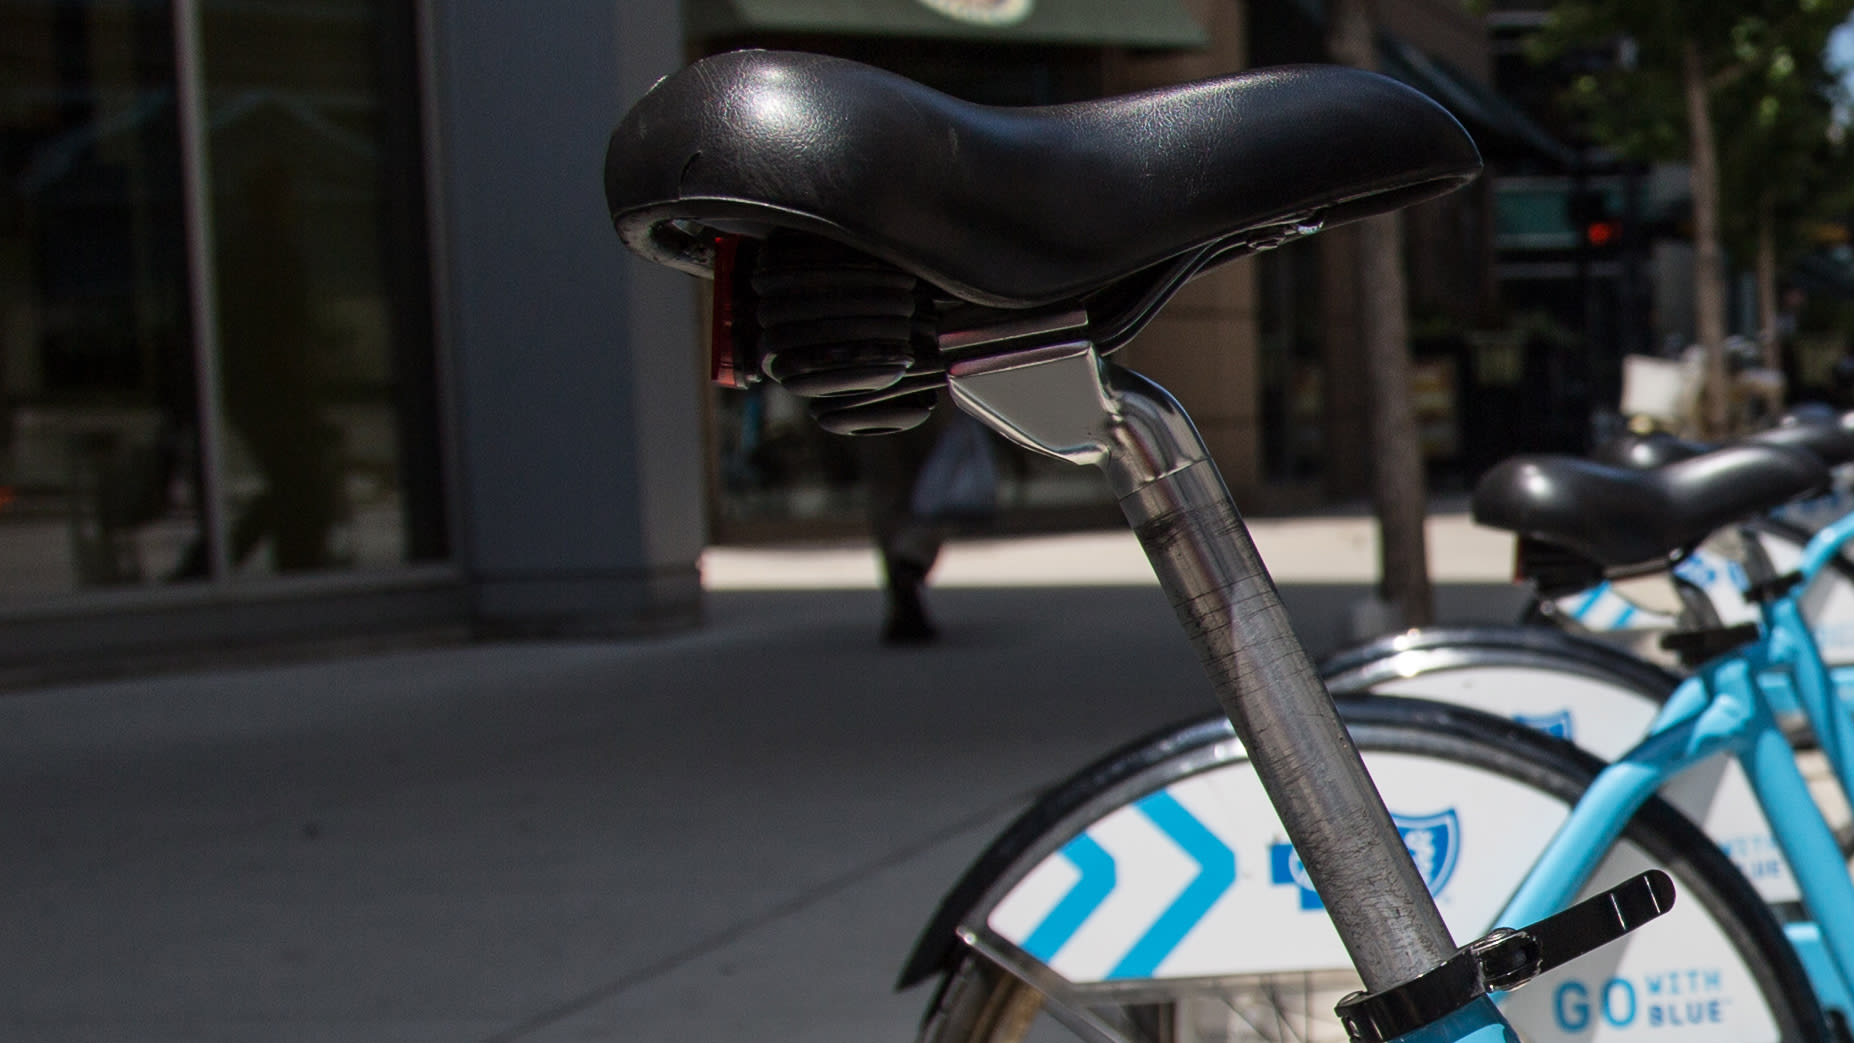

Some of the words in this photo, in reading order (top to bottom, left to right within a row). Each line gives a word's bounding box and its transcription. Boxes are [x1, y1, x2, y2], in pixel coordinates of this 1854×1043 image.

[1553, 977, 1638, 1034] GO
[1645, 969, 1721, 995] WITH
[1648, 999, 1722, 1027] BLUE
